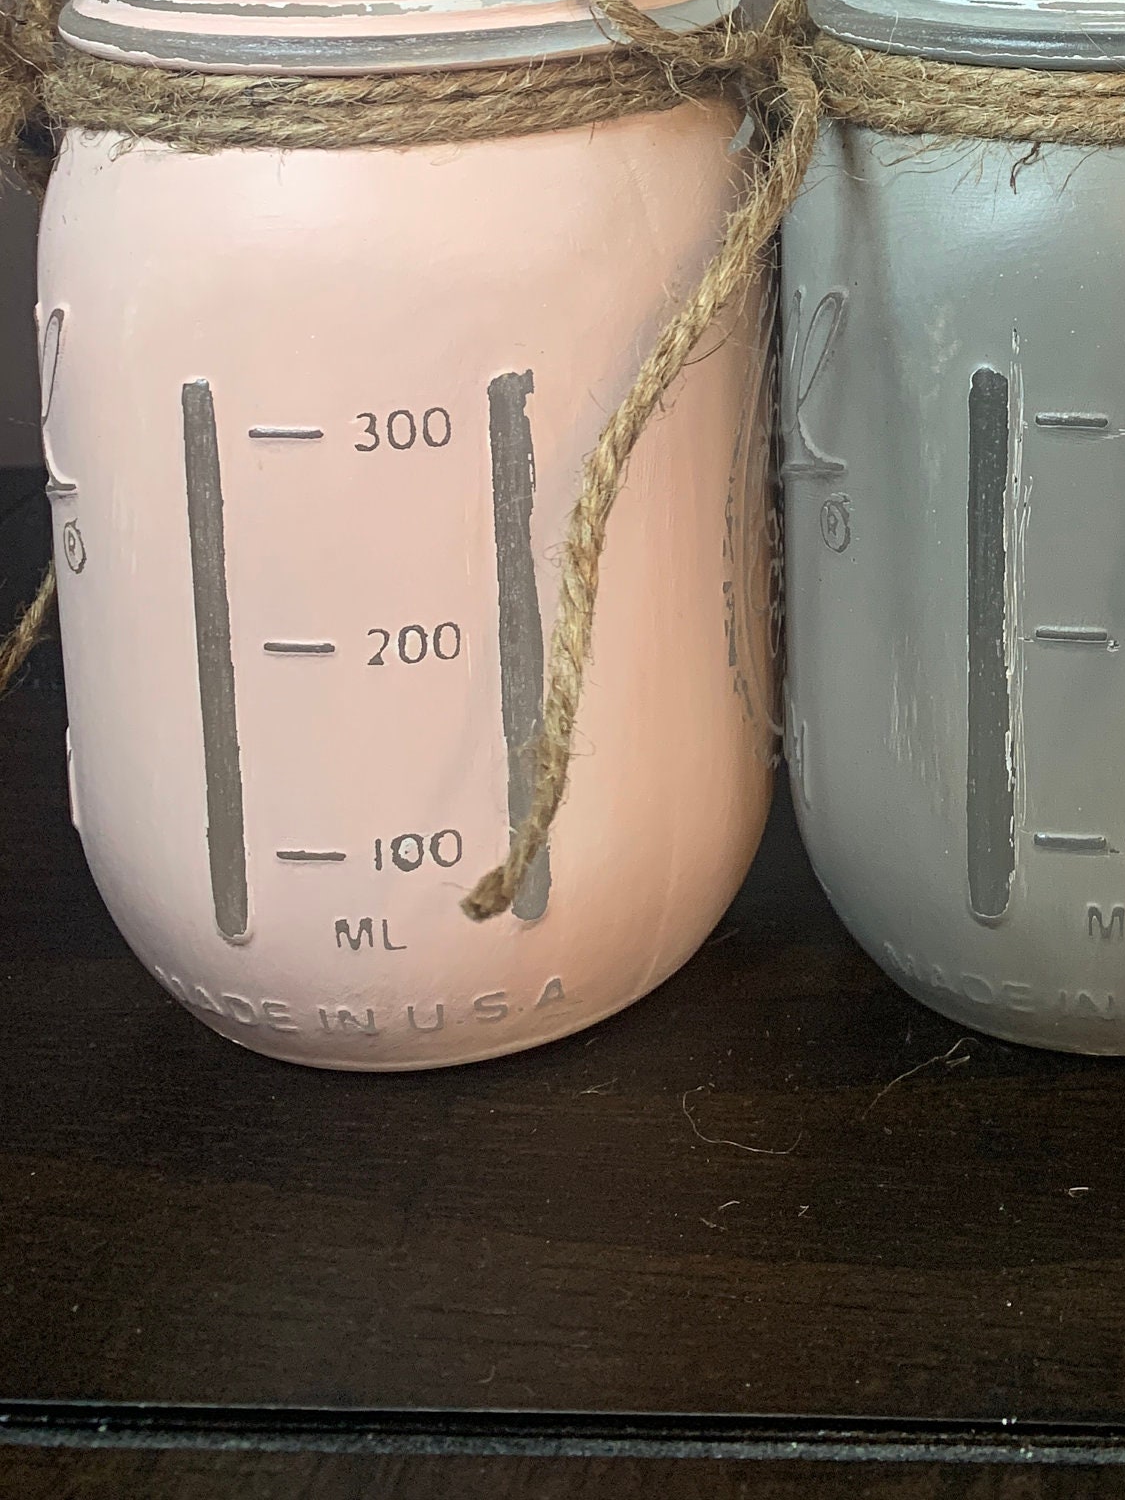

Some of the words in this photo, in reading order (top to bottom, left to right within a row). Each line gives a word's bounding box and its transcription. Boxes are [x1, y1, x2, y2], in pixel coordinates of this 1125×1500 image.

[353, 406, 453, 453] 300
[366, 621, 462, 667] 200
[373, 828, 464, 873] 100
[334, 916, 408, 951] ML
[317, 1007, 378, 1035] IN
[1058, 989, 1116, 1021] IN
